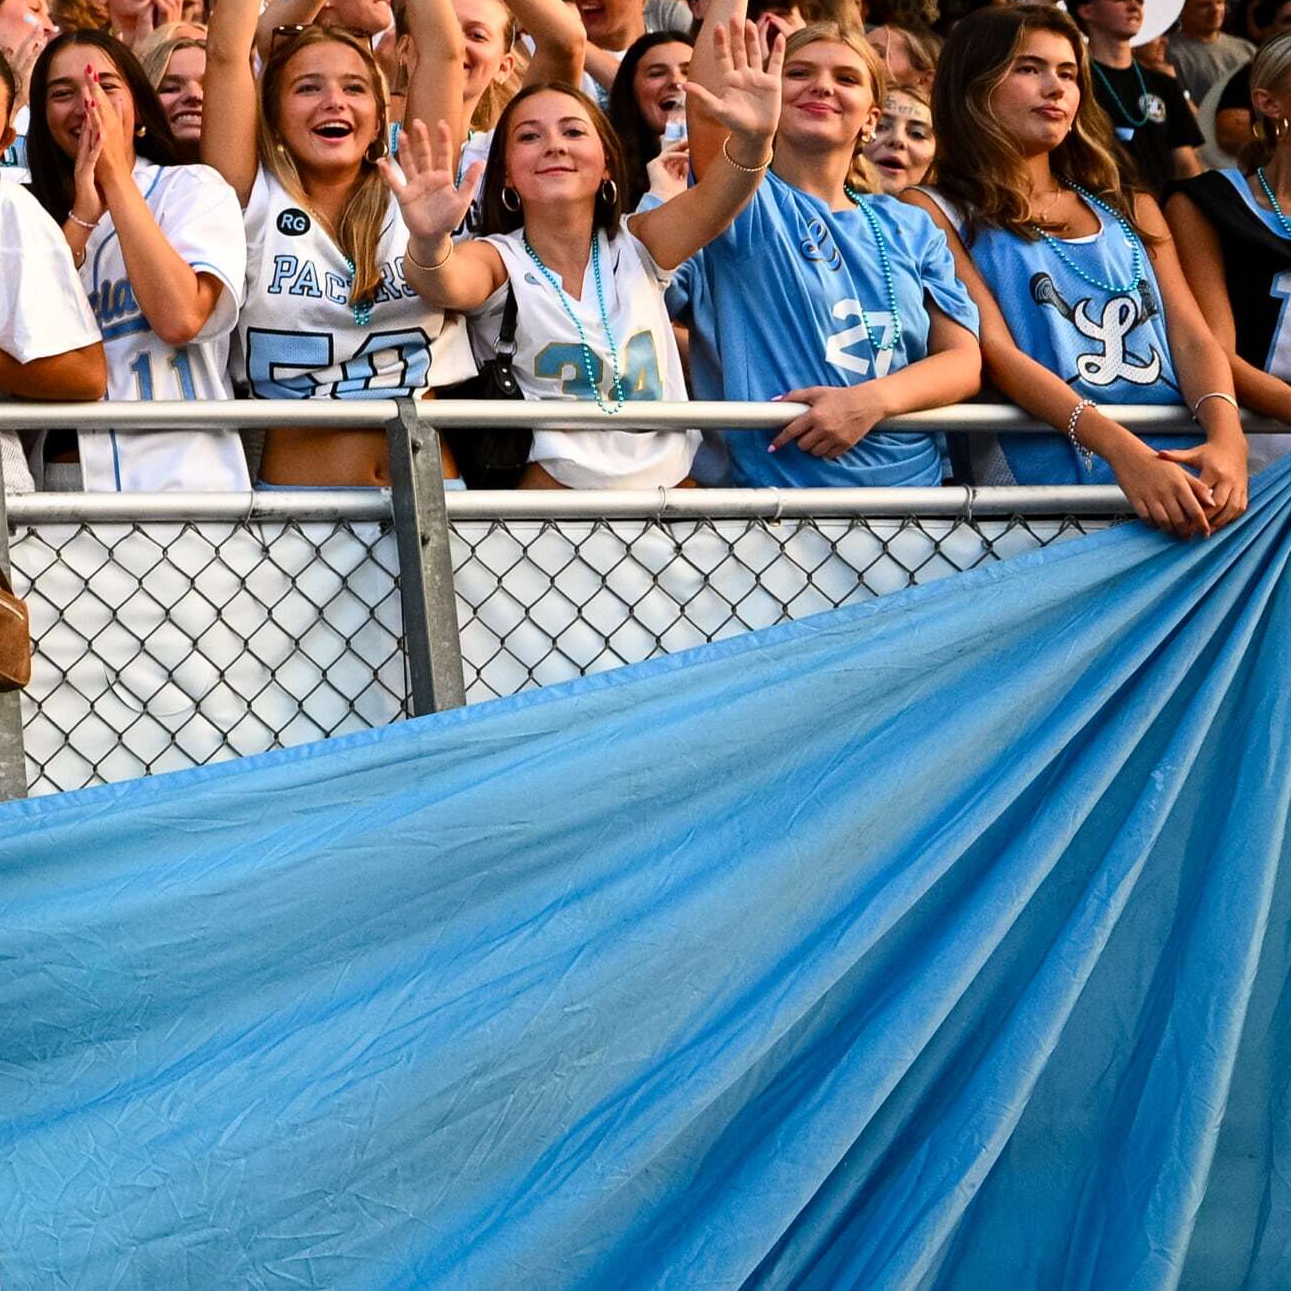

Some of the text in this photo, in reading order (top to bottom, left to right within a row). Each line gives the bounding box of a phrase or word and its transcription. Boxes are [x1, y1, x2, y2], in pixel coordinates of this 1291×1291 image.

[280, 214, 306, 231] RG
[826, 298, 903, 379] 27
[1074, 295, 1161, 386] L
